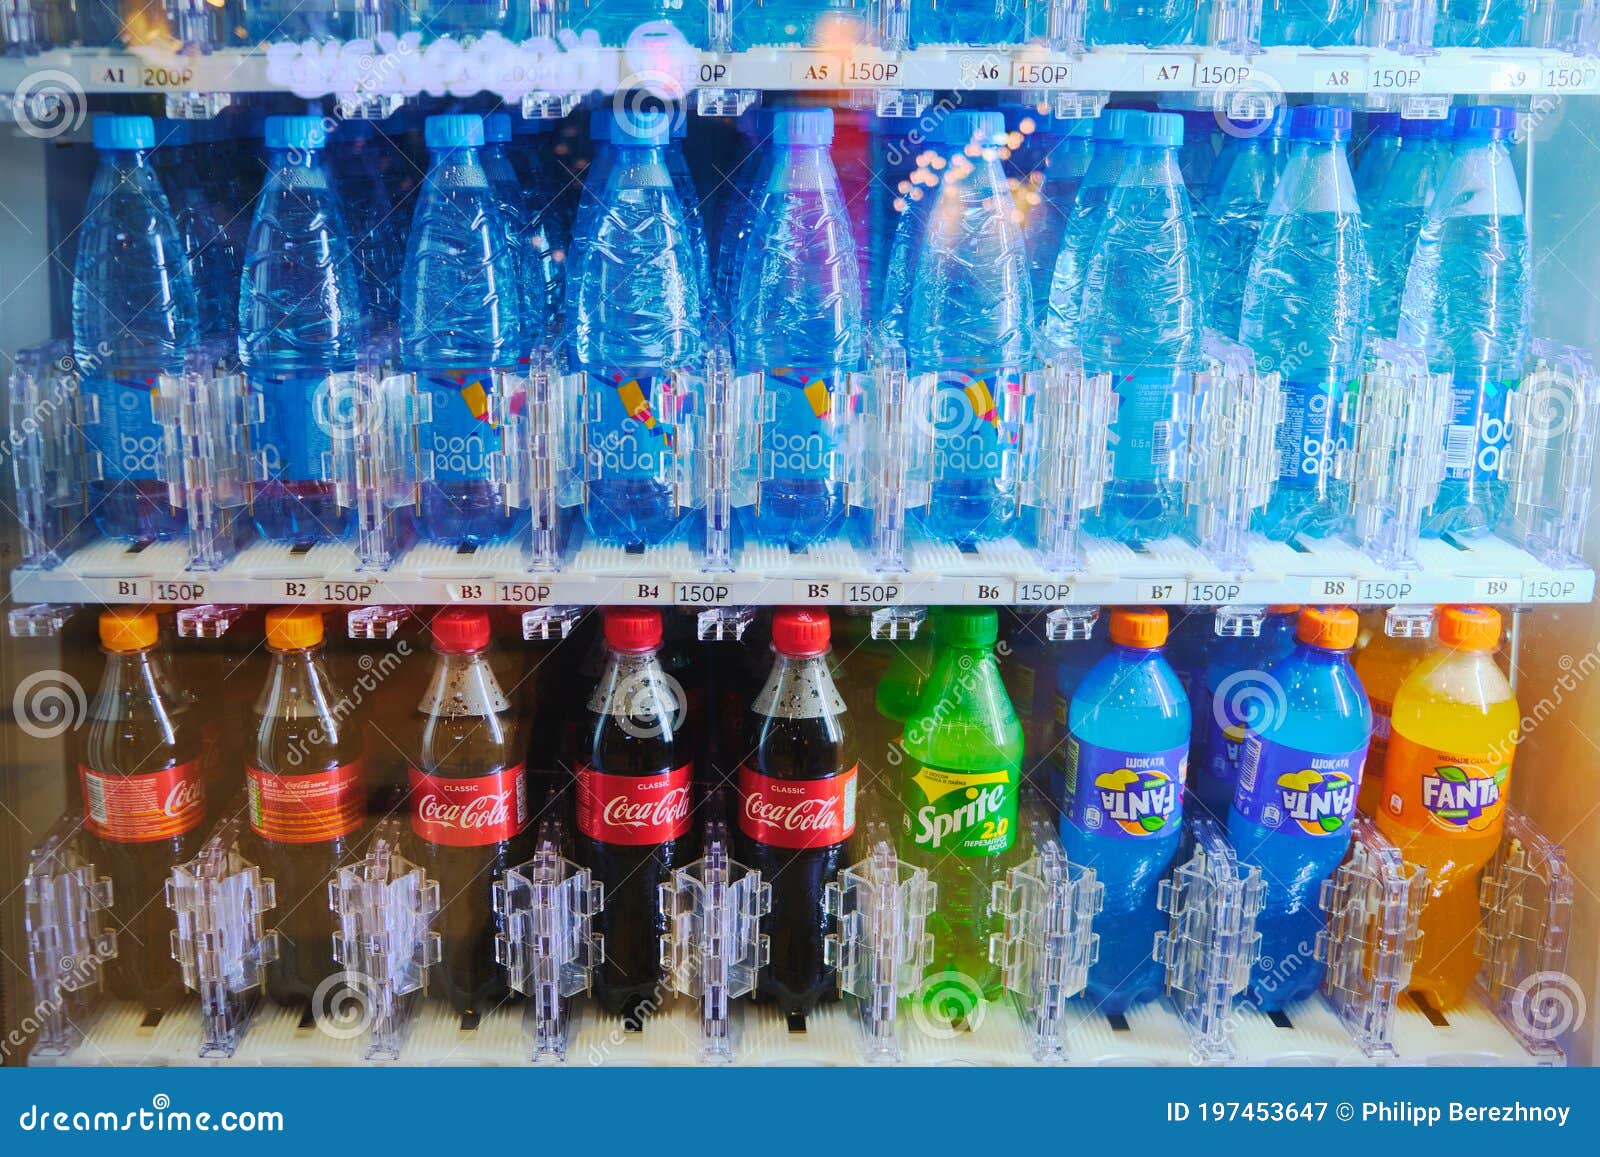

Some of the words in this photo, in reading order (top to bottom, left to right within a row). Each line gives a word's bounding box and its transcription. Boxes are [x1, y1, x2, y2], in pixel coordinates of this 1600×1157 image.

[103, 69, 126, 83] A1
[804, 65, 829, 80] A5
[975, 64, 999, 80] A6
[1156, 65, 1181, 81] A7
[1326, 70, 1350, 87] A8
[433, 431, 483, 453] bon
[772, 430, 823, 452] bon
[118, 580, 138, 596] B1
[285, 582, 307, 597] B2
[460, 584, 482, 599] B3
[637, 583, 660, 599] B4
[807, 583, 830, 598] B5
[977, 585, 1000, 600] B6
[1151, 585, 1174, 600] B7
[1323, 580, 1345, 596] B8
[1486, 580, 1508, 596] B9
[637, 780, 671, 791] CLASSIC
[771, 784, 806, 795] CLASSIC
[1422, 776, 1499, 809] FANTA
[419, 789, 512, 829] Coca-Cola
[1100, 783, 1175, 821] FANTA
[1282, 784, 1354, 821] FANTA
[746, 792, 840, 831] Coca-Cola
[915, 784, 1006, 849] Sprite
[980, 817, 1009, 840] 2.0
